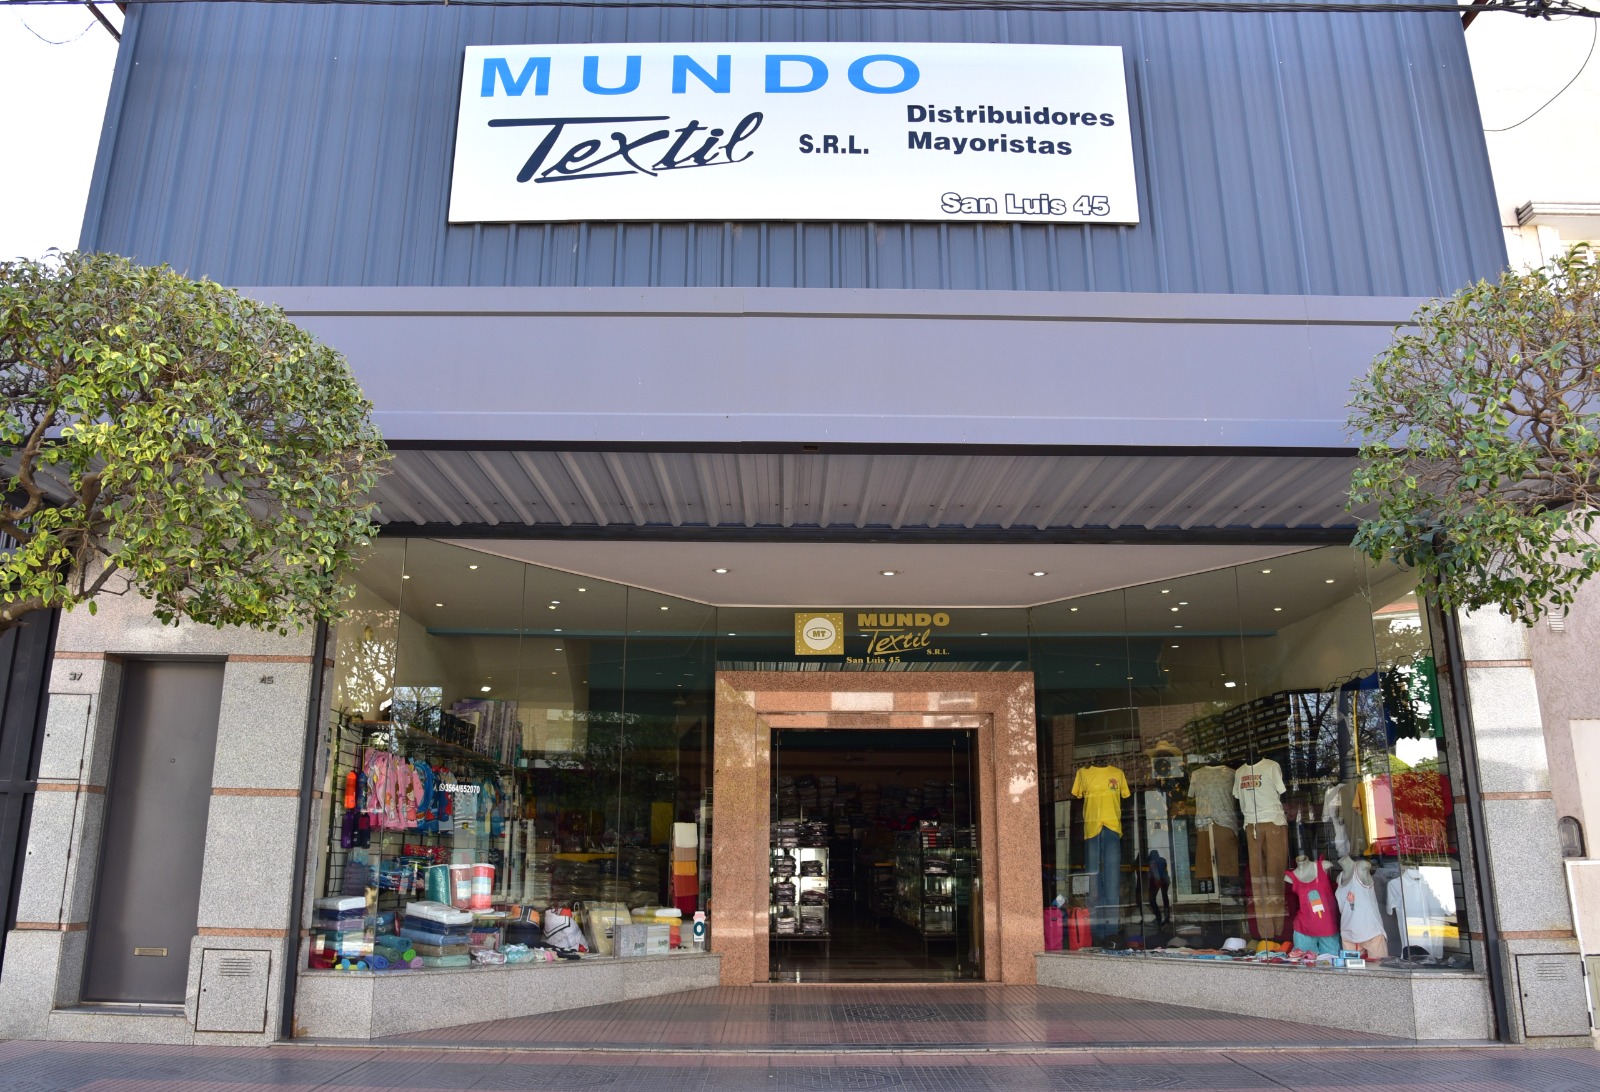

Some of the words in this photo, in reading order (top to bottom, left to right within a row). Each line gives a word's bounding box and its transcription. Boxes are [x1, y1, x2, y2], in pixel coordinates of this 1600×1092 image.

[480, 54, 920, 97] MUNDO
[906, 104, 1115, 127] Distribuidores
[487, 111, 764, 184] Textil
[798, 133, 869, 154] S.R.L.
[907, 130, 1073, 155] Mayoristas
[941, 192, 998, 214] San
[1005, 193, 1068, 216] Luis
[1073, 195, 1110, 216] 45
[857, 613, 950, 627] MUNDO
[812, 630, 826, 638] MT
[859, 629, 931, 656] Textil
[846, 656, 864, 664] San
[866, 656, 886, 664] Luis
[888, 656, 901, 664] 45
[926, 648, 950, 656] S.R.L.
[69, 672, 83, 681] 37
[260, 675, 274, 685] 45
